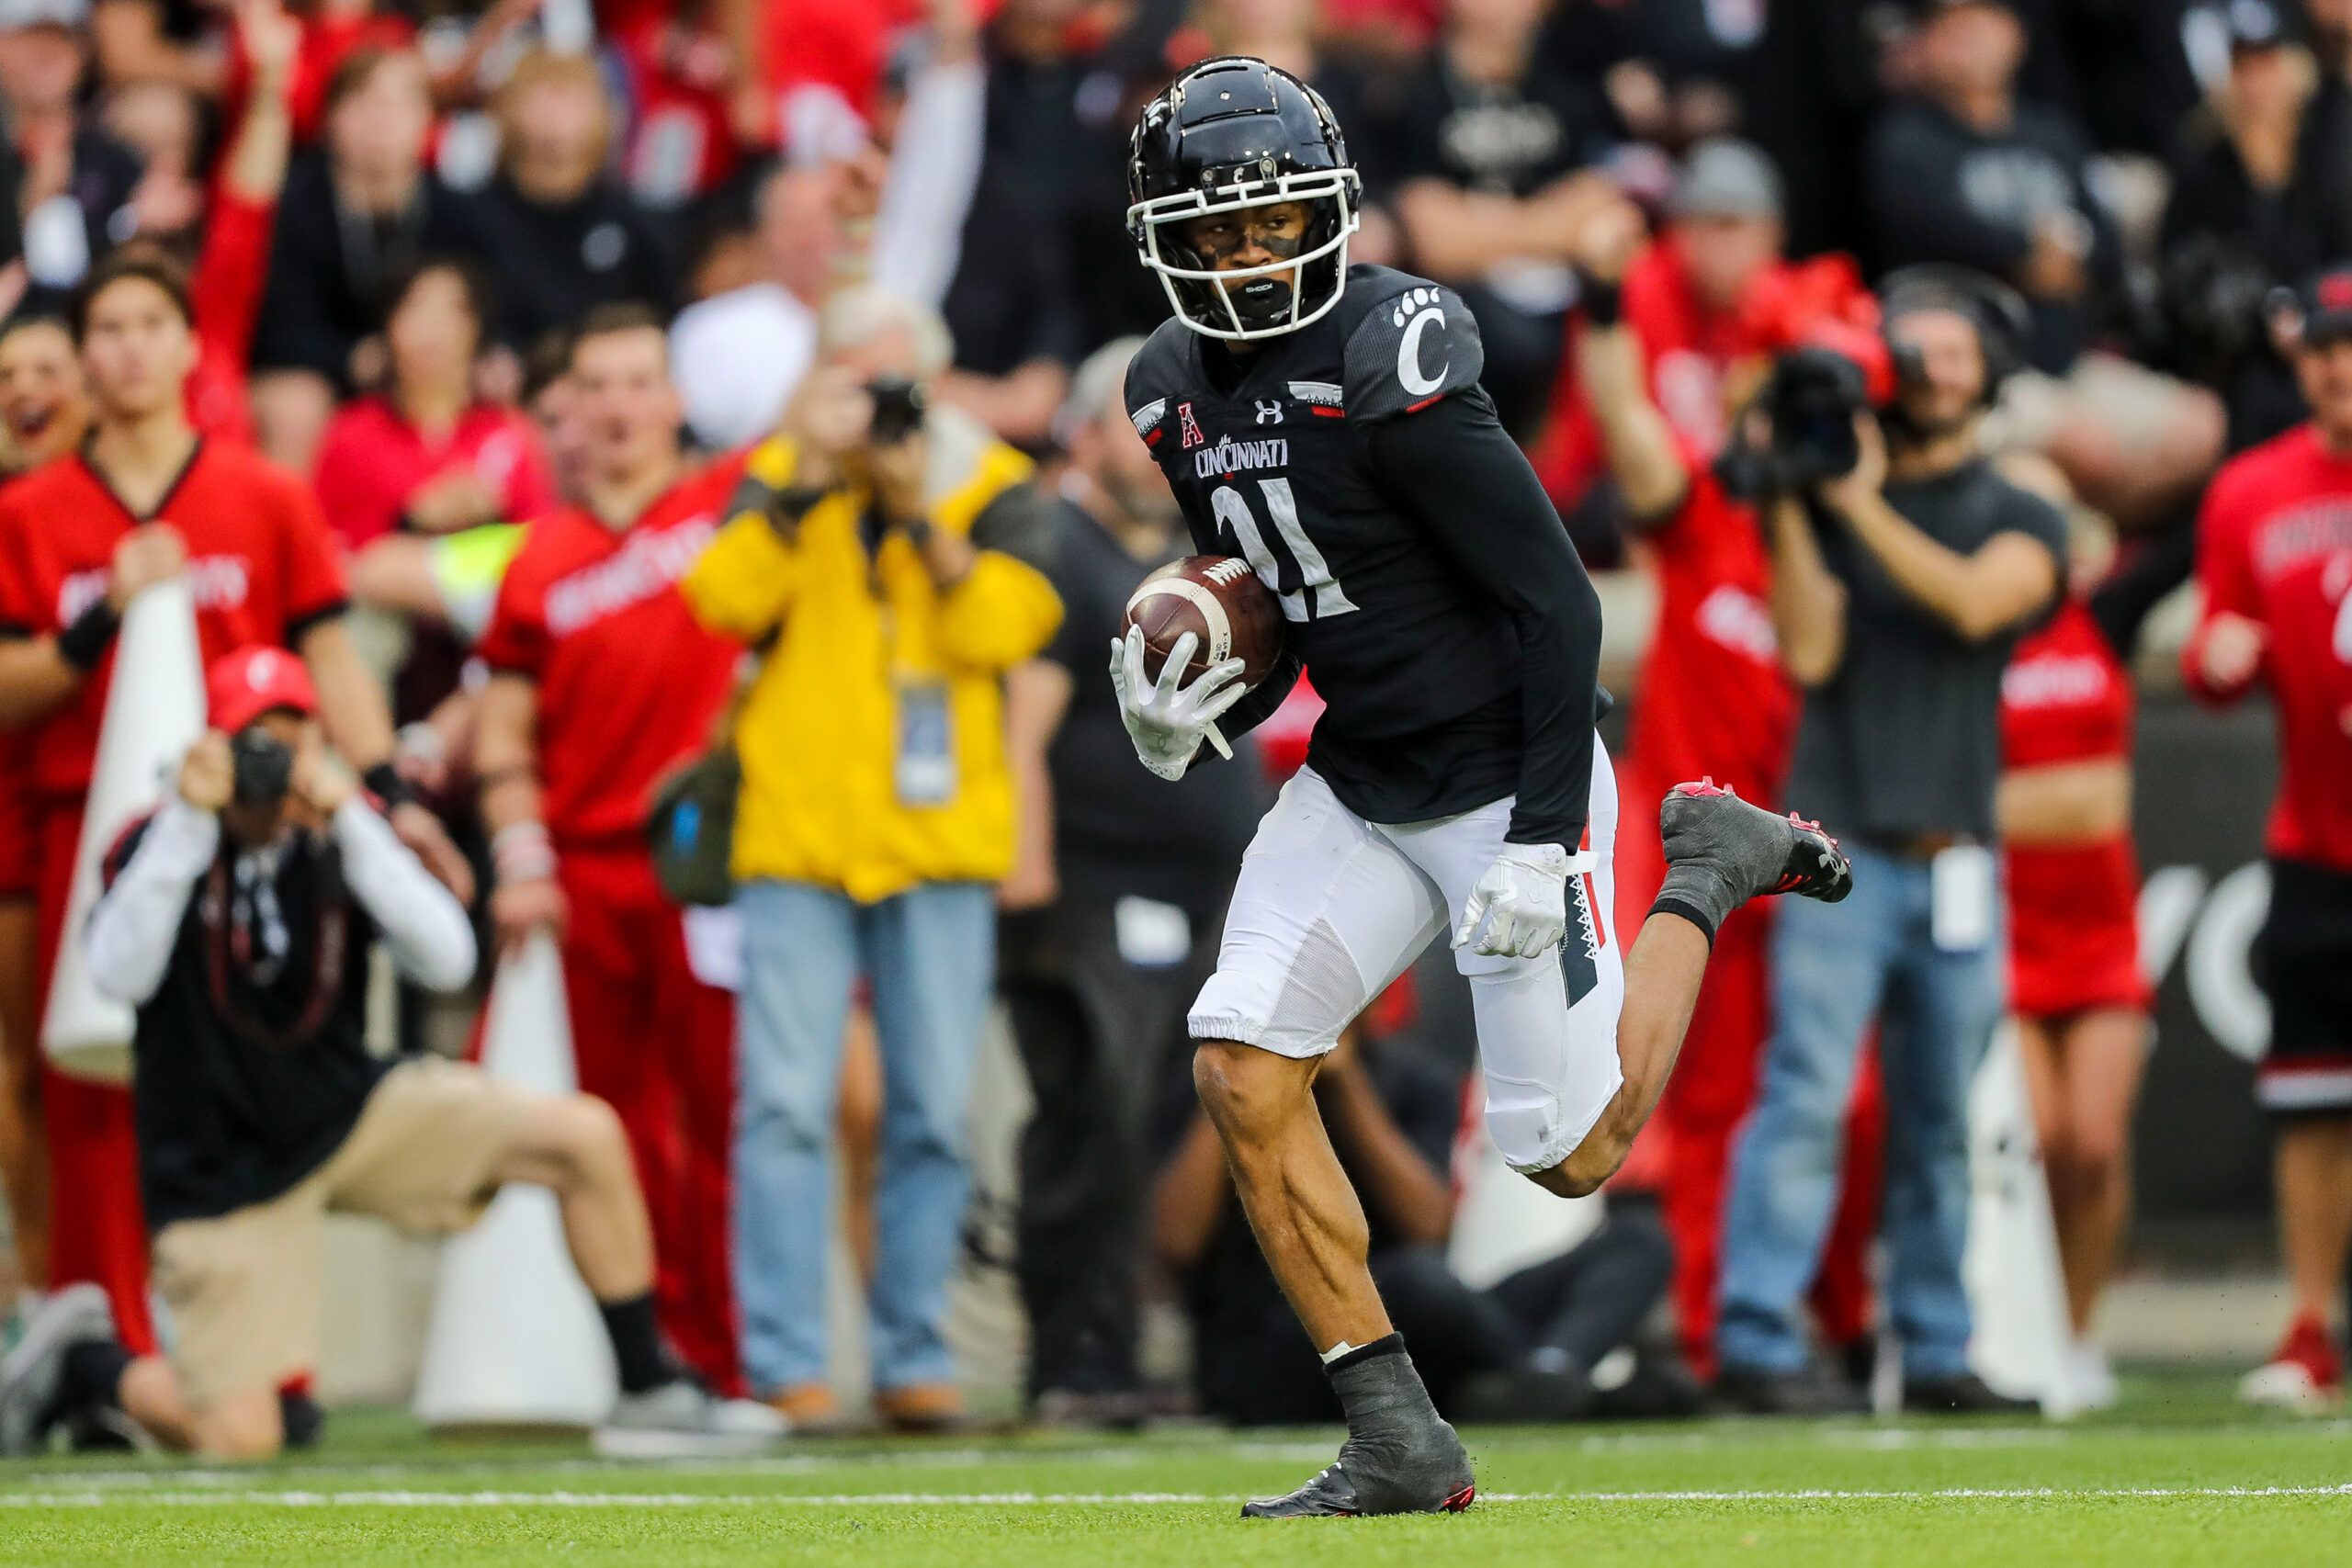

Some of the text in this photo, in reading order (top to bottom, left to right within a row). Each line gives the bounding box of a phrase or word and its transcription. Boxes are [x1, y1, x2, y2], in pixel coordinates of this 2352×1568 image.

[1245, 283, 1273, 293] SHOCK
[1396, 307, 1449, 396] C
[1178, 402, 1204, 448] A
[1194, 438, 1288, 479] CINCINNATI
[1210, 477, 1361, 623] 21
